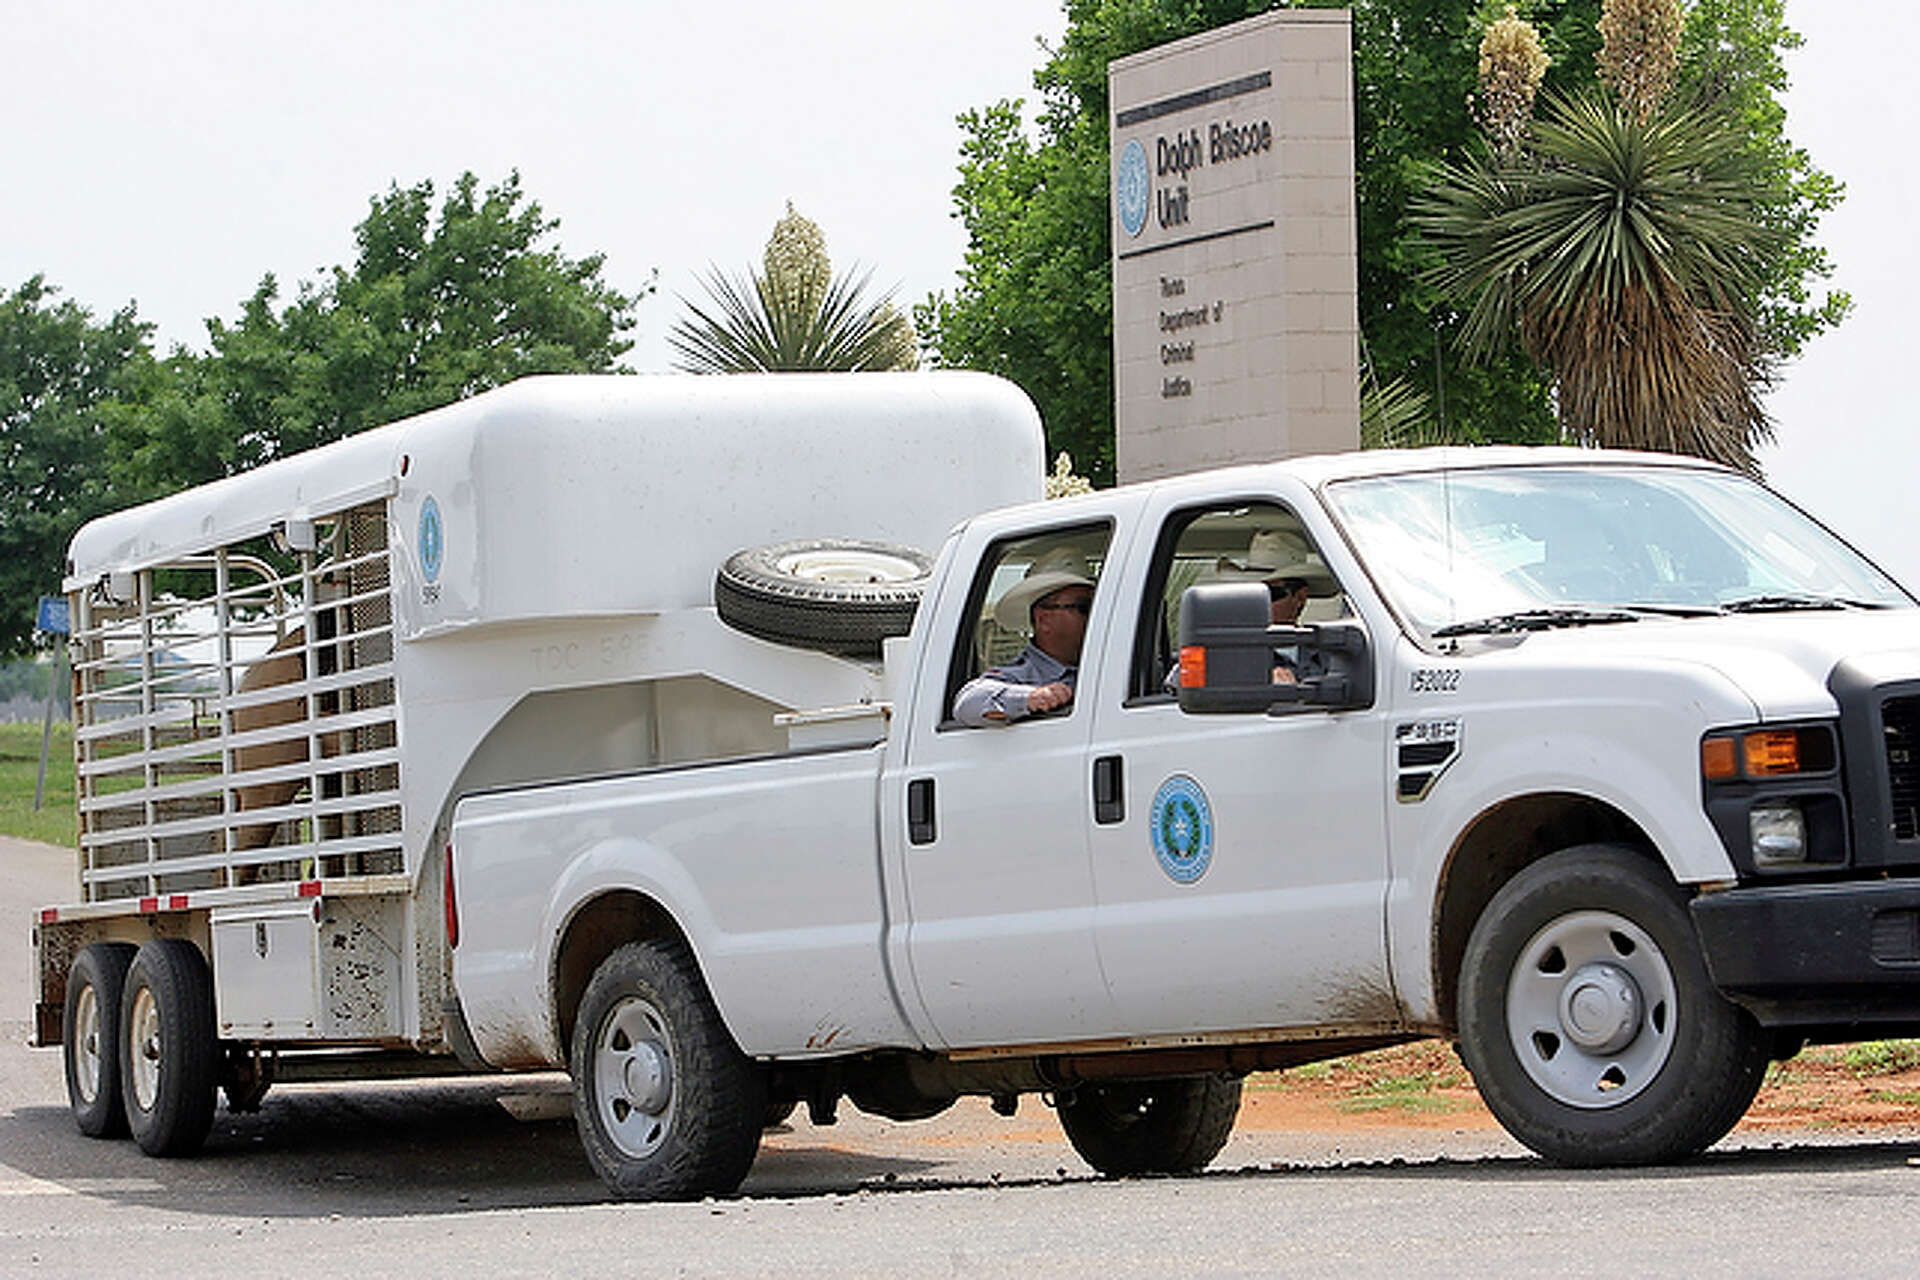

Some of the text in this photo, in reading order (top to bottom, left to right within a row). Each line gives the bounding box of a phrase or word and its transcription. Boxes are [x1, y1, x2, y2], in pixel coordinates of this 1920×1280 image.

[1157, 120, 1272, 180] Dolph Briscoe
[1156, 186, 1190, 229] Unit
[1160, 300, 1224, 334] Department of
[1160, 341, 1195, 366] Criminal
[1161, 375, 1192, 399] Justice
[1409, 668, 1461, 693] 152022
